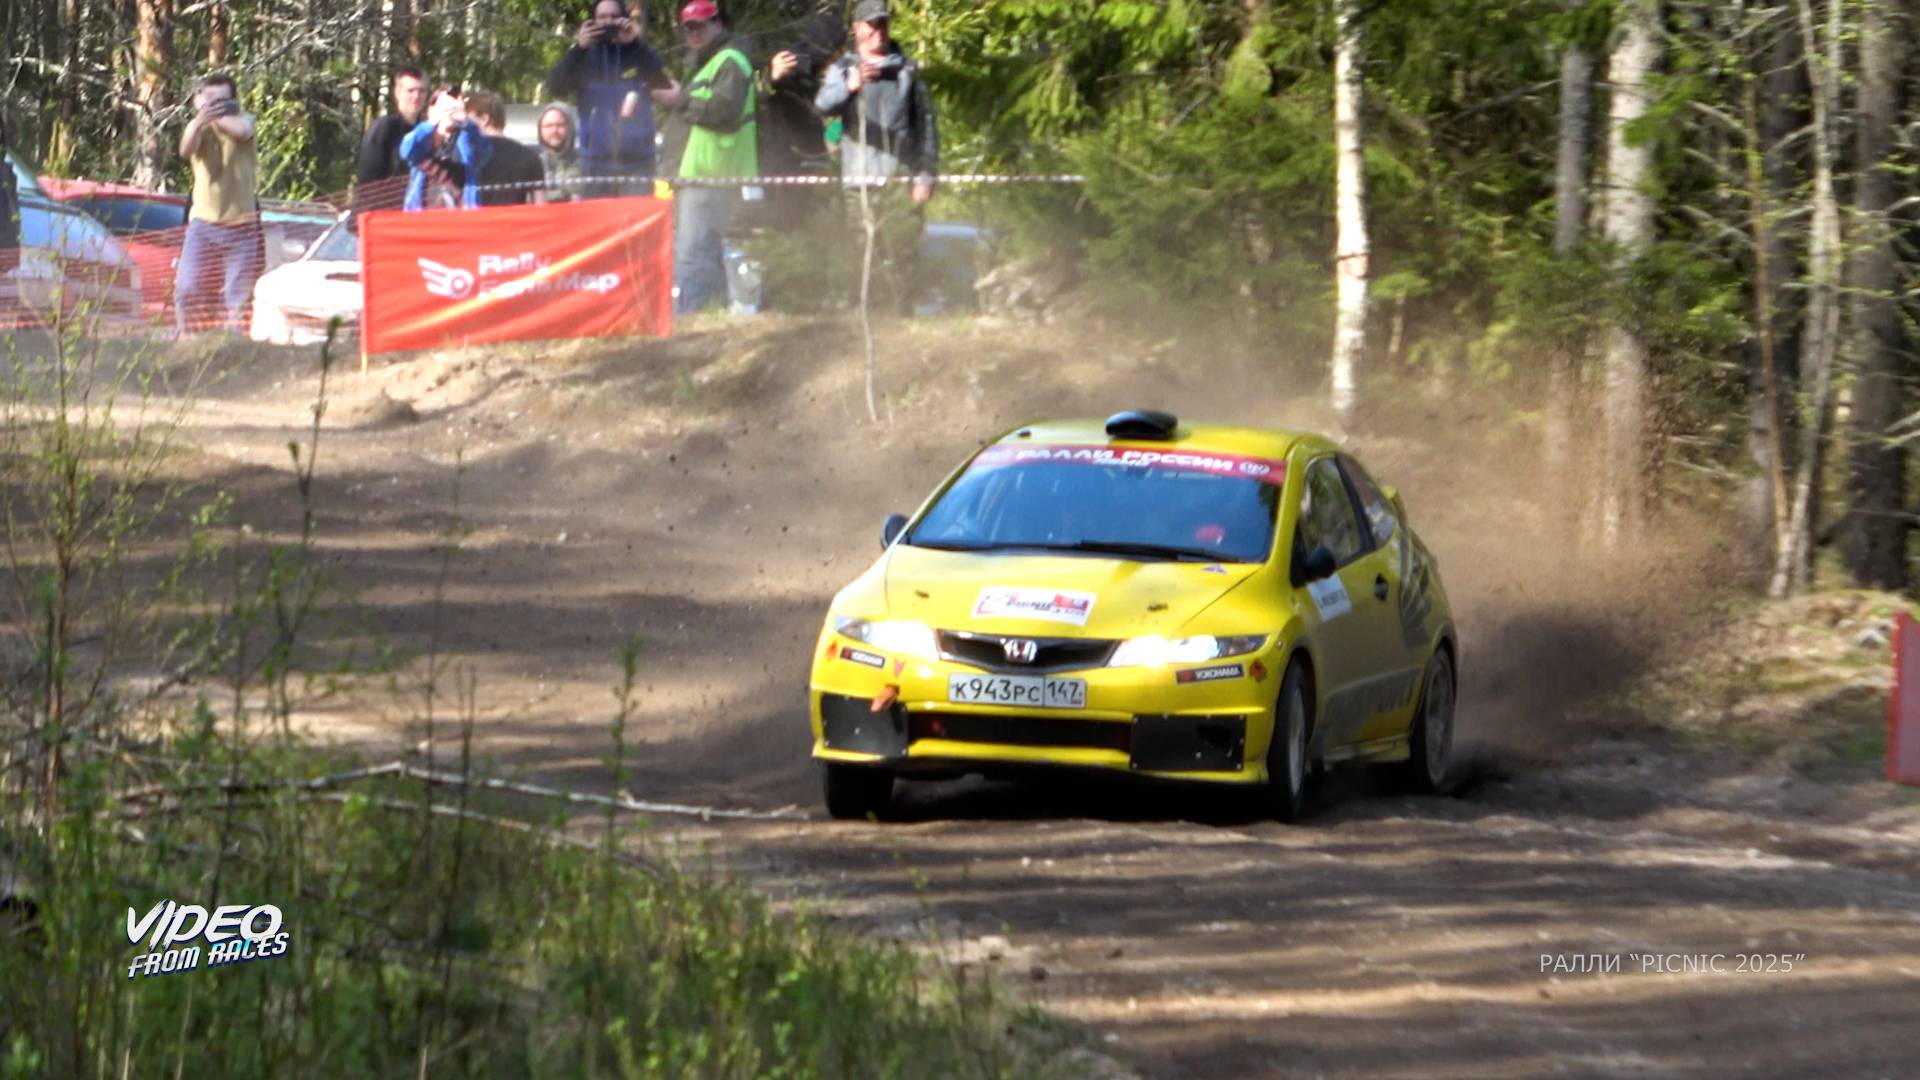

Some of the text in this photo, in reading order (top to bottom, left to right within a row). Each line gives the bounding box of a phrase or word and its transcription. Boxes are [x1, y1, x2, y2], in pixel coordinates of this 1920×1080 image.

[479, 252, 550, 276] Rally
[1015, 449, 1115, 461] РАЛЛИ
[1121, 450, 1234, 471] РОССИИ
[1047, 680, 1080, 699] 147
